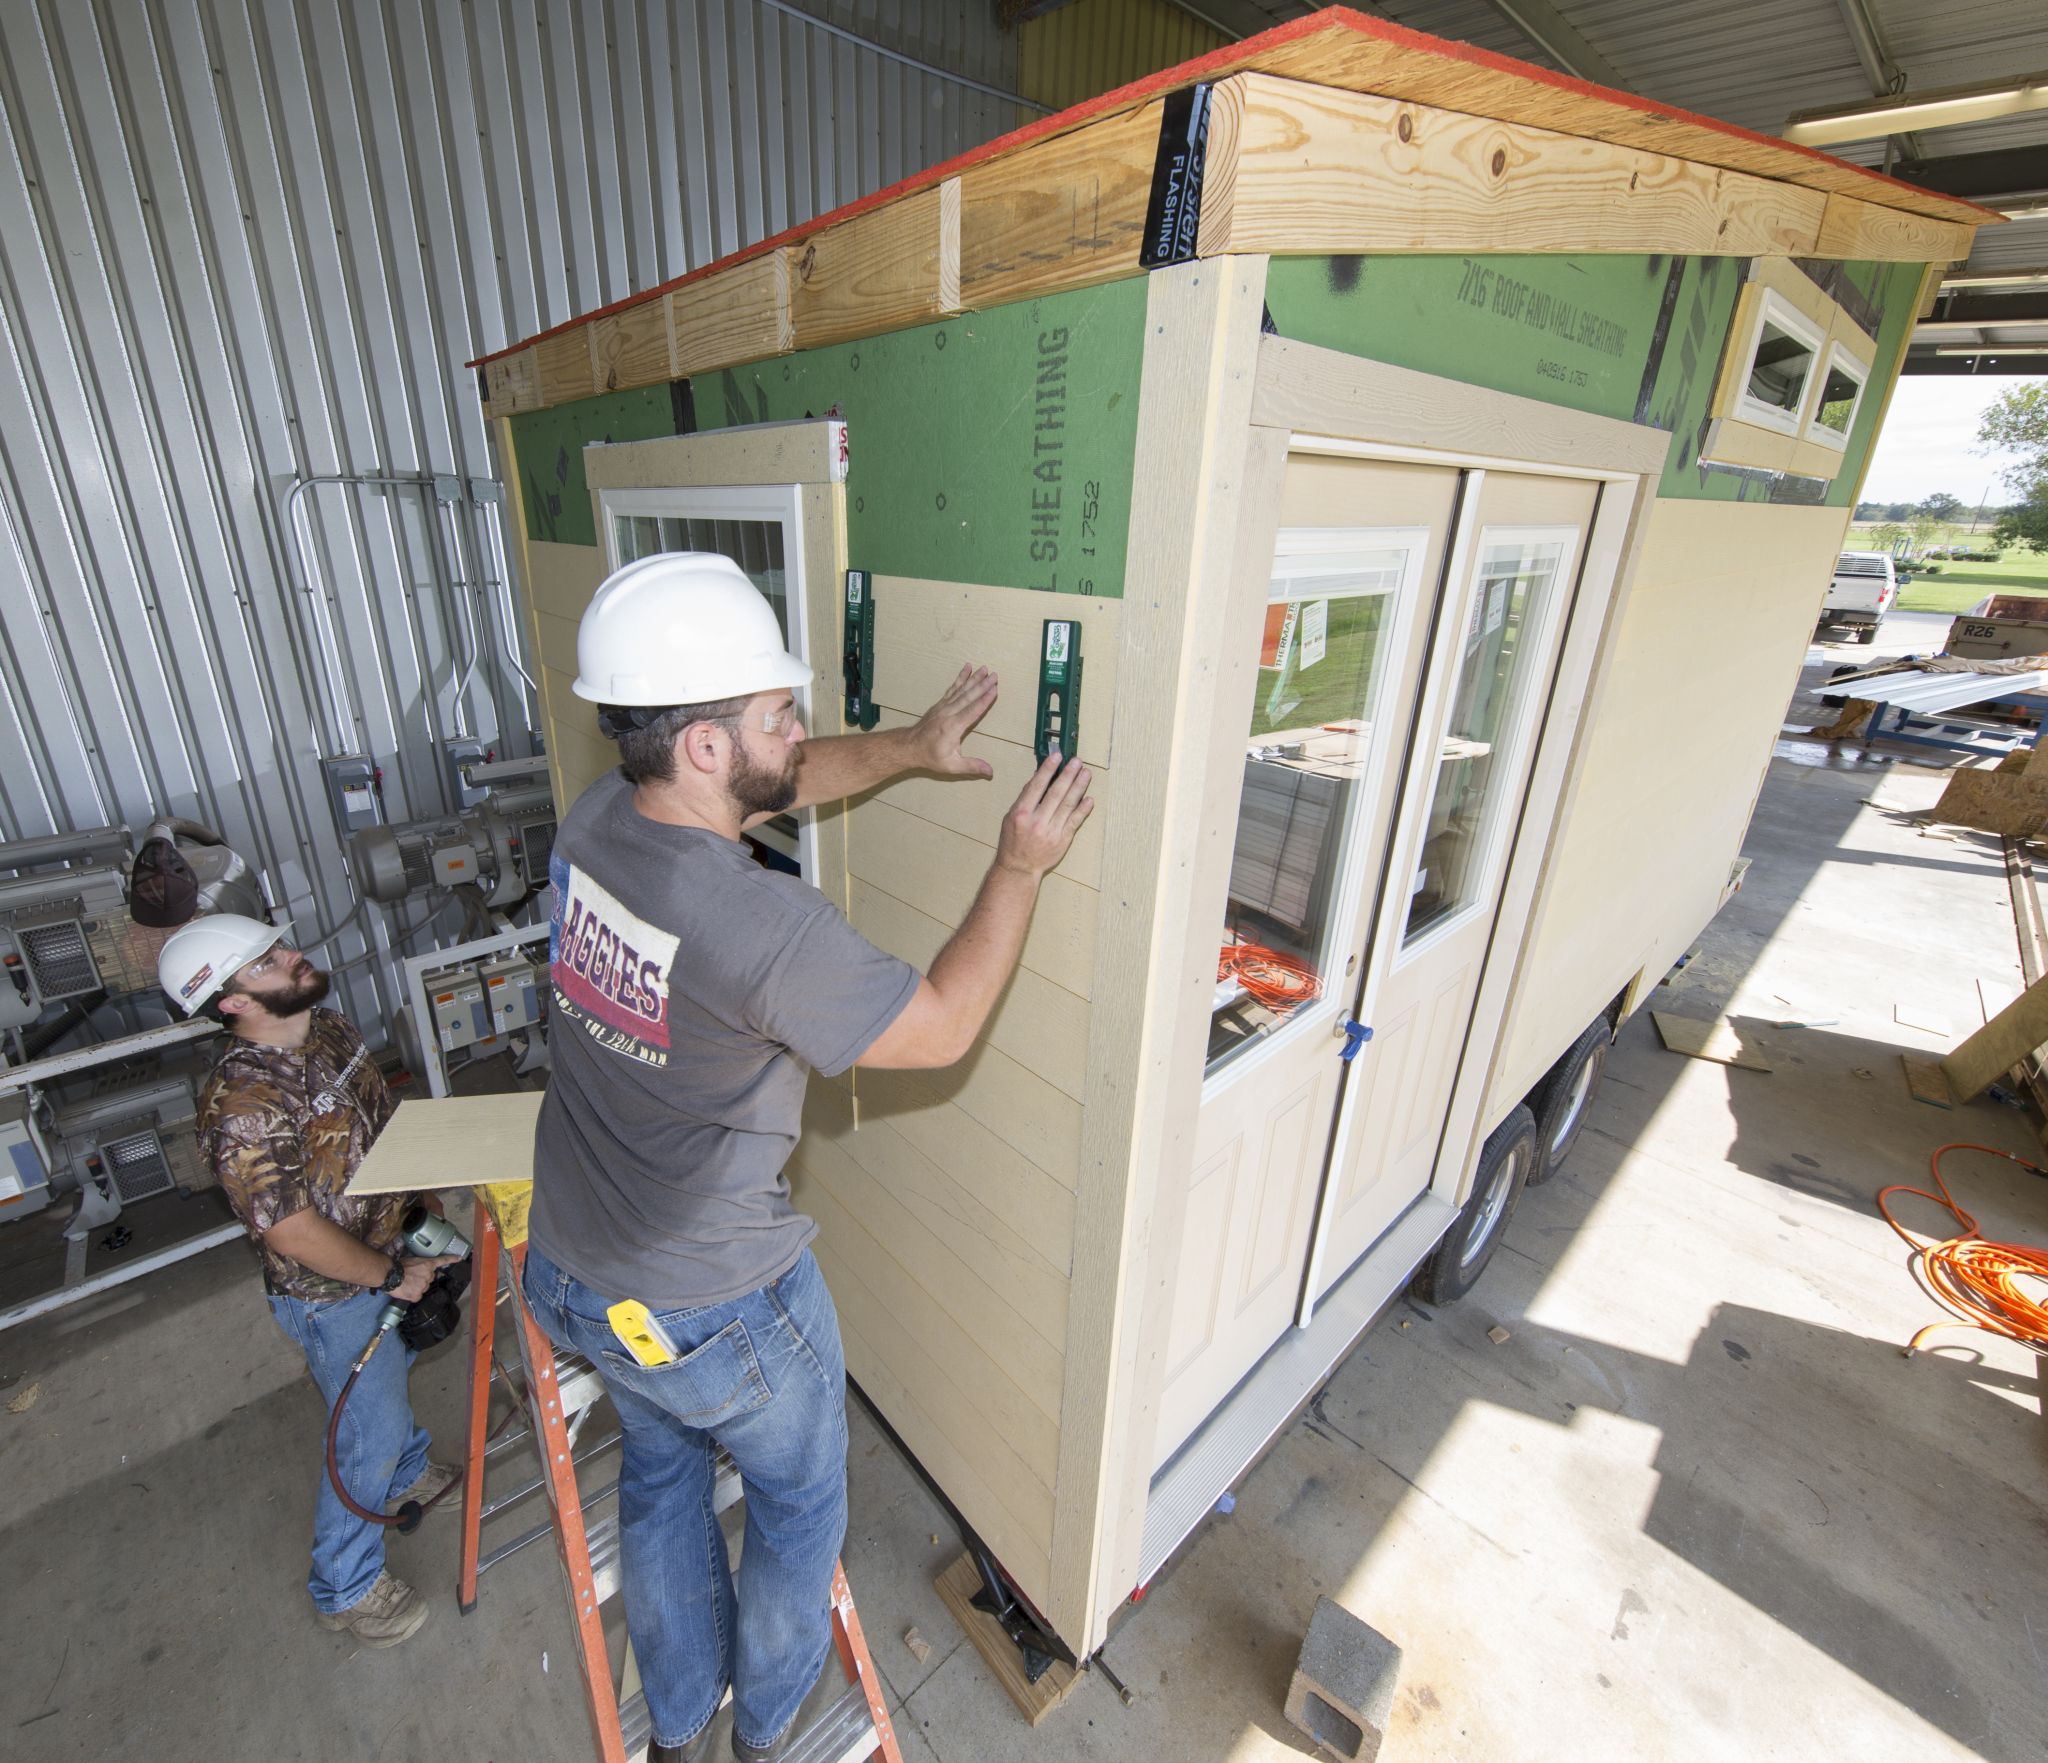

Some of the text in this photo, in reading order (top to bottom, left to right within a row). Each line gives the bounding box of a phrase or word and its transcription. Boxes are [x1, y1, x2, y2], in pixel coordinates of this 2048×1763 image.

[1158, 155, 1185, 258] FLASHING
[1492, 273, 1529, 321] ROOF
[1524, 288, 1551, 330] AND
[1550, 298, 1578, 342] WALL
[1576, 311, 1628, 358] SHEATHING
[1030, 326, 1070, 562] SHEATHING
[1081, 480, 1100, 556] 1752
[1275, 621, 1292, 666] THERMA
[1963, 625, 1996, 638] R26
[559, 896, 664, 1023] AGGIES
[585, 1019, 608, 1039] THE
[607, 1030, 640, 1054] 12th
